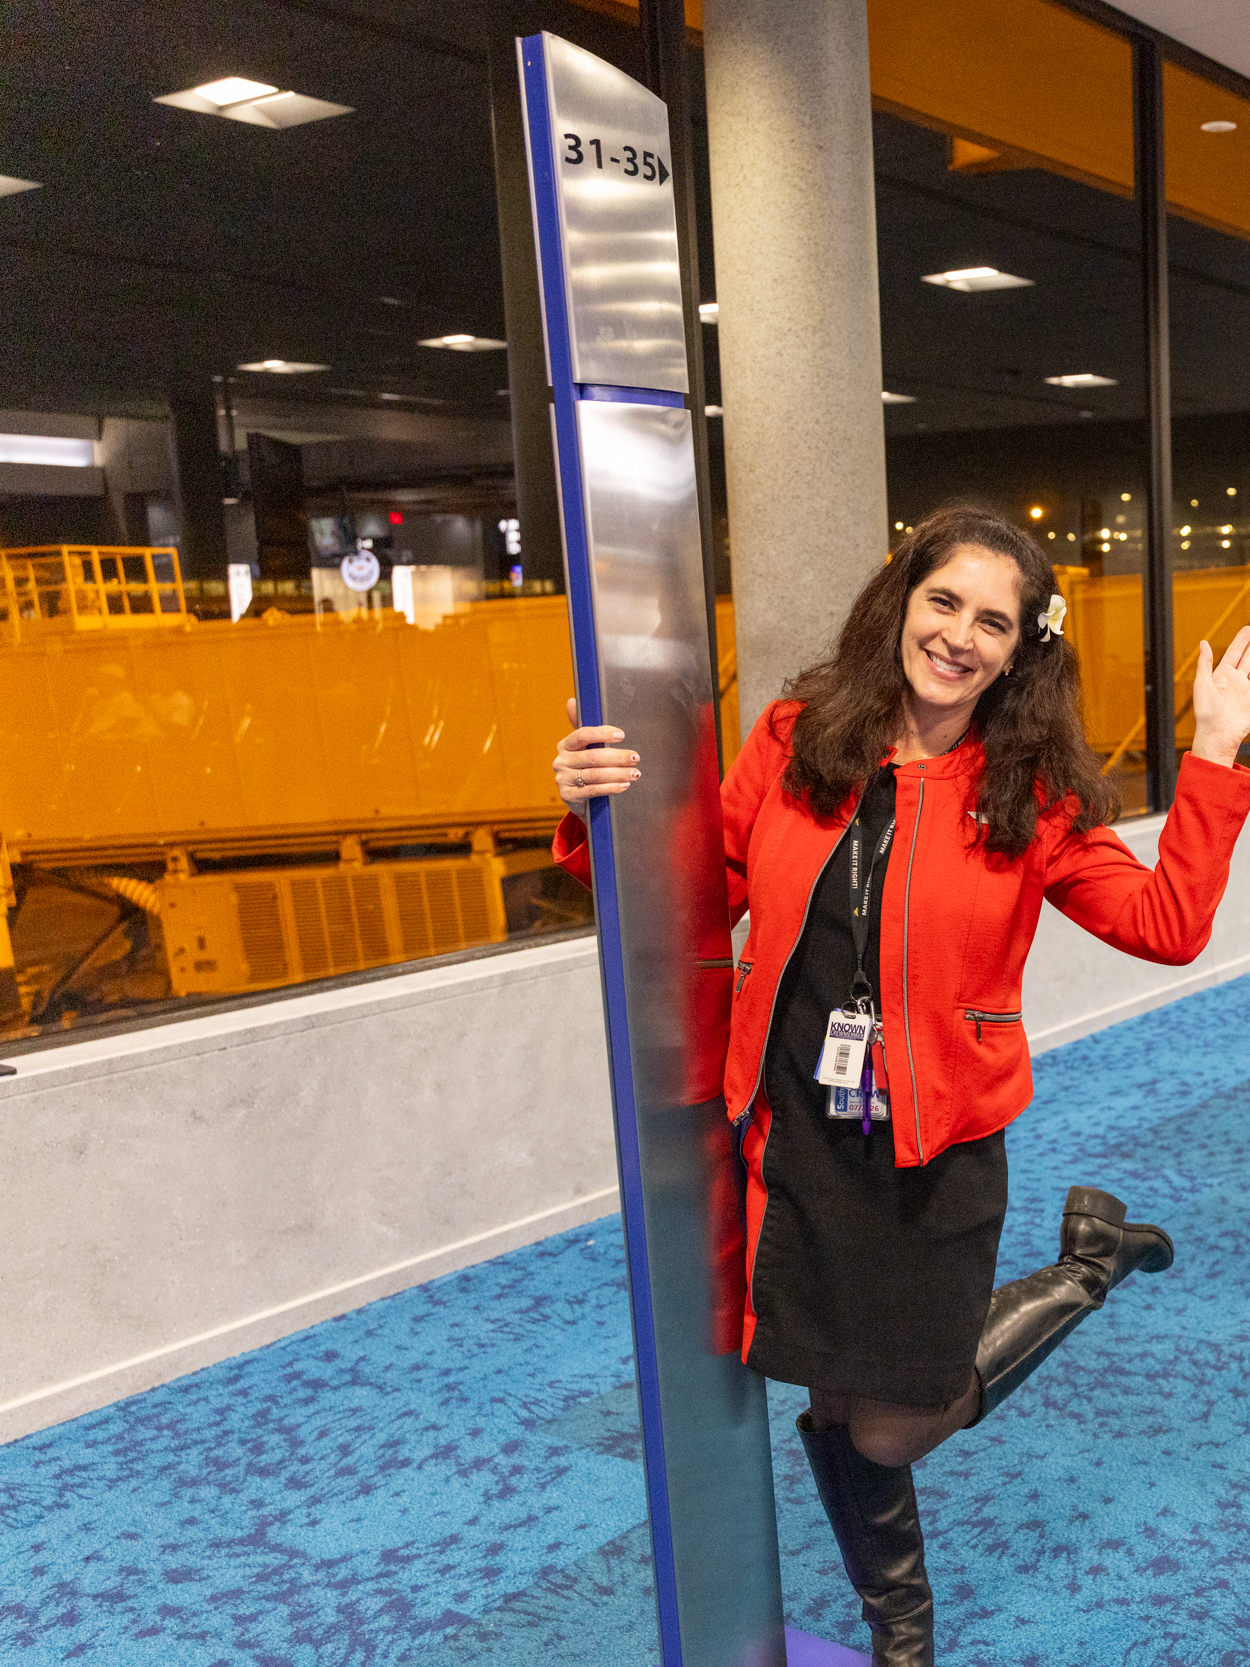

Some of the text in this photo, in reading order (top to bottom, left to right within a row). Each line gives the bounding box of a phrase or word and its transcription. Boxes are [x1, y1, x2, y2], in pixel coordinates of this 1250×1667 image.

[563, 133, 657, 182] 31-35
[879, 835, 890, 854] MAKE
[887, 828, 893, 837] IT
[861, 896, 869, 916] MAKE
[831, 1022, 866, 1034] KNOWN
